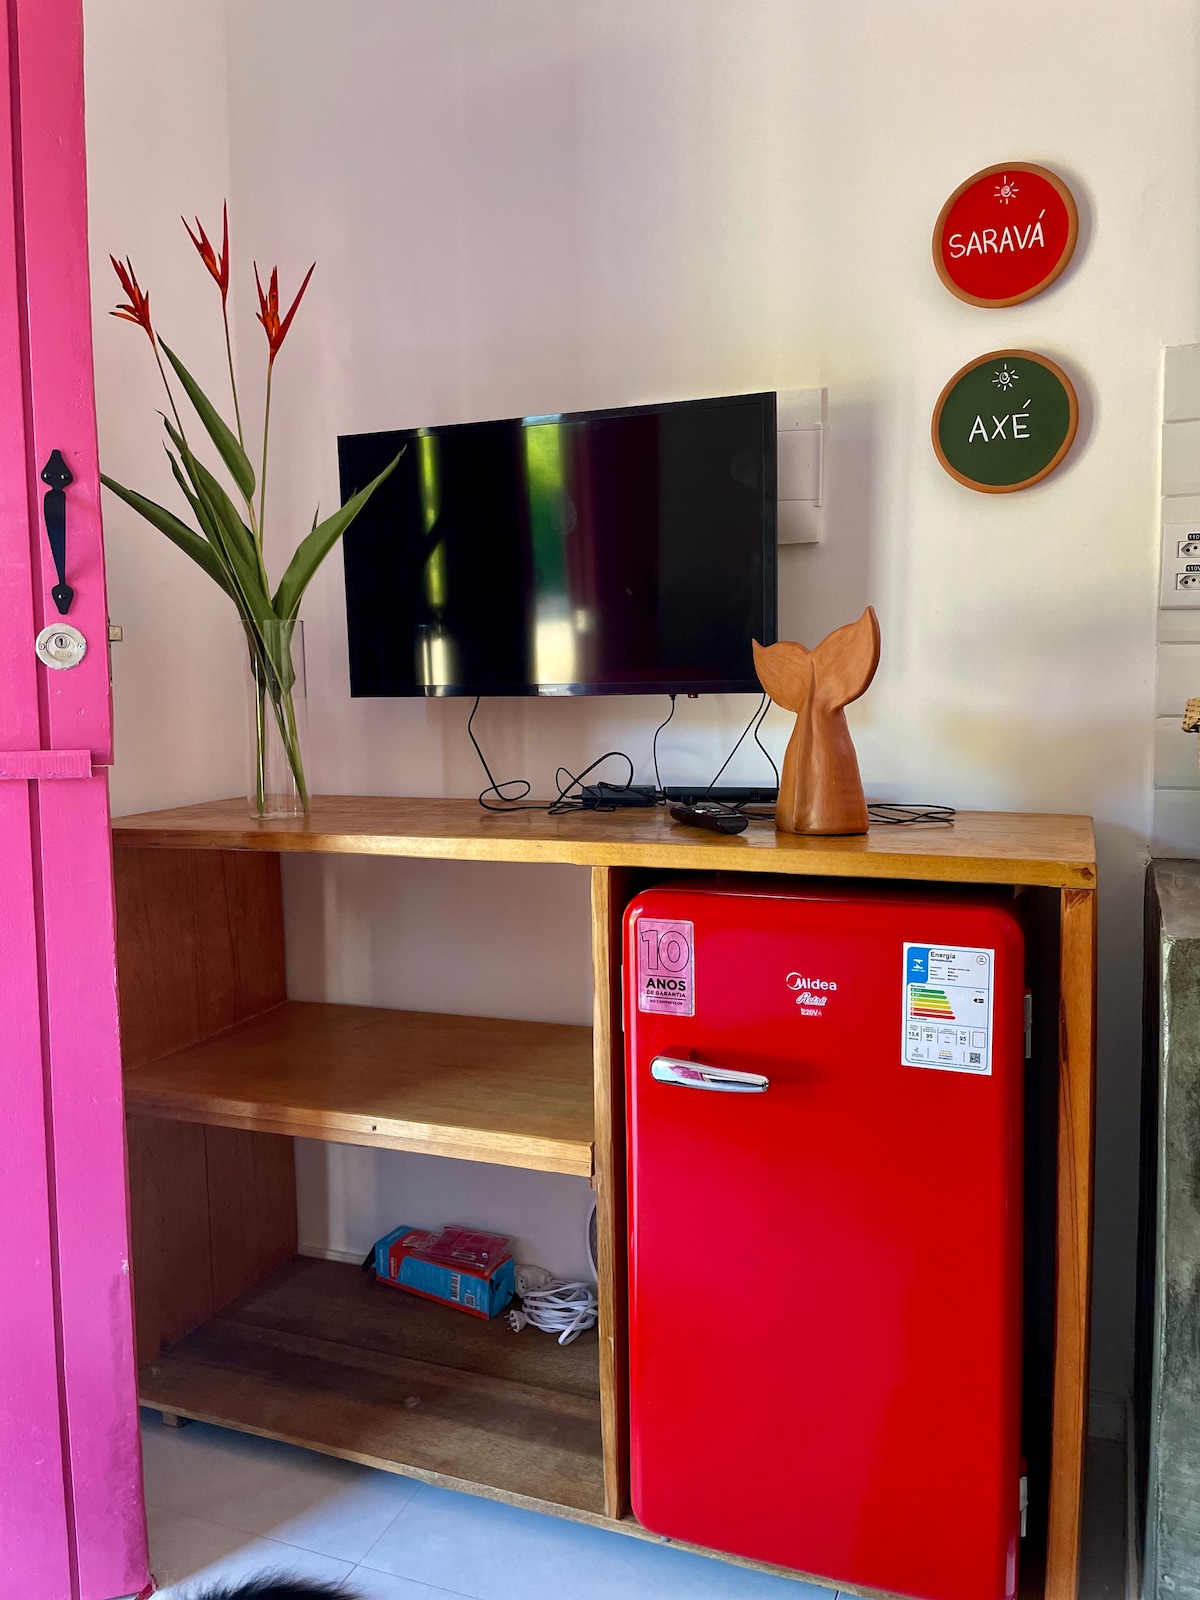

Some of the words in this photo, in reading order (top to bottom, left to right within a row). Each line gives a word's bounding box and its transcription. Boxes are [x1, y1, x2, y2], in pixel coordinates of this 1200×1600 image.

[948, 208, 1045, 258] SARAVÁ
[968, 398, 1031, 443] AXÉ
[641, 929, 690, 973] 10
[930, 951, 956, 960] Energia
[645, 977, 687, 991] ANOS
[787, 973, 837, 991] Midea
[655, 990, 687, 998] GARANTIA
